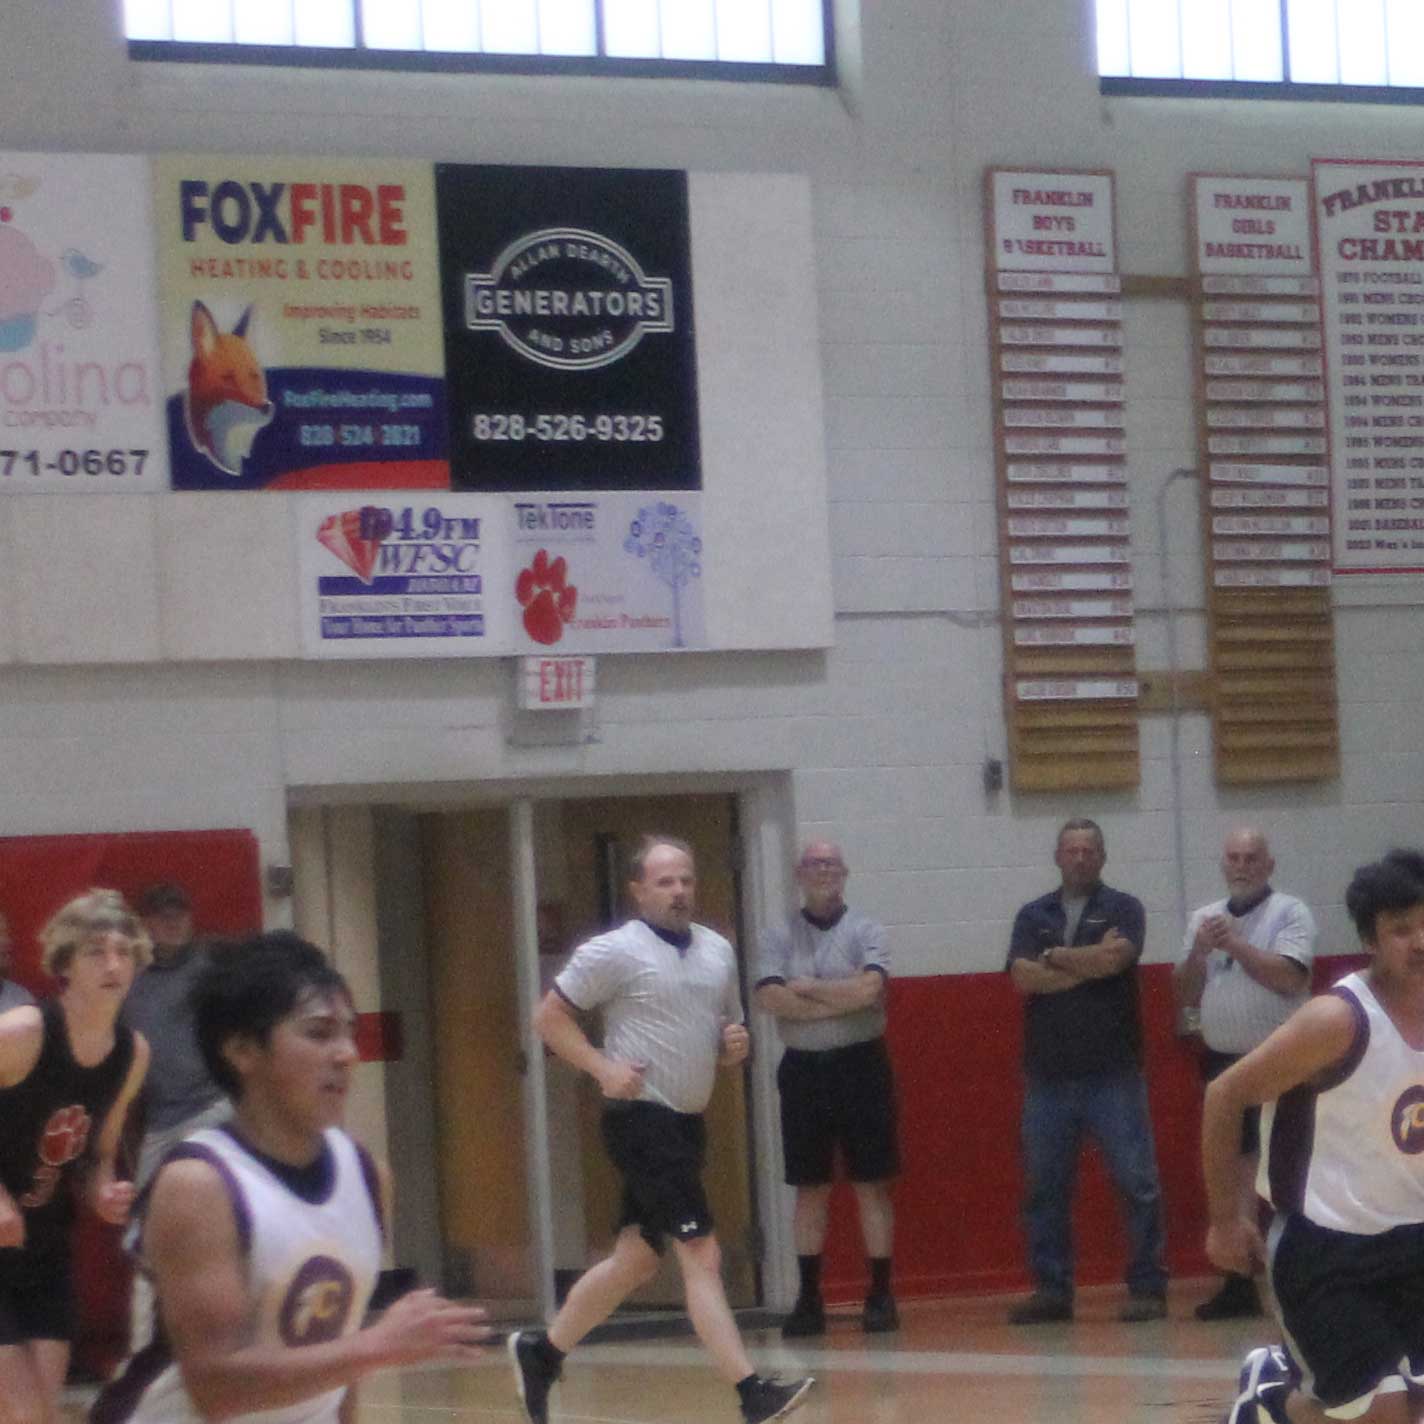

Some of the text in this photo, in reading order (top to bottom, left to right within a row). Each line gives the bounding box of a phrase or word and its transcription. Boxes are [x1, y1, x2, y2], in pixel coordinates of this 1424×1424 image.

[1013, 190, 1094, 208] FRANKLIN
[1213, 193, 1292, 212] FRANKLIN
[180, 180, 408, 246] FOXFIRE
[1033, 215, 1076, 231] BOYS
[1231, 218, 1277, 236] GIRLS
[1205, 242, 1305, 261] BASKETBALL
[189, 257, 414, 282] HEATING & COOLING
[476, 289, 662, 319] GENERATORS
[528, 328, 615, 355] AND SONS
[473, 413, 665, 443] 828-526-9325
[0, 449, 150, 477] 71-0667
[514, 503, 599, 530] TekTone
[378, 542, 483, 574] WFSC
[540, 659, 585, 703] EXIT
